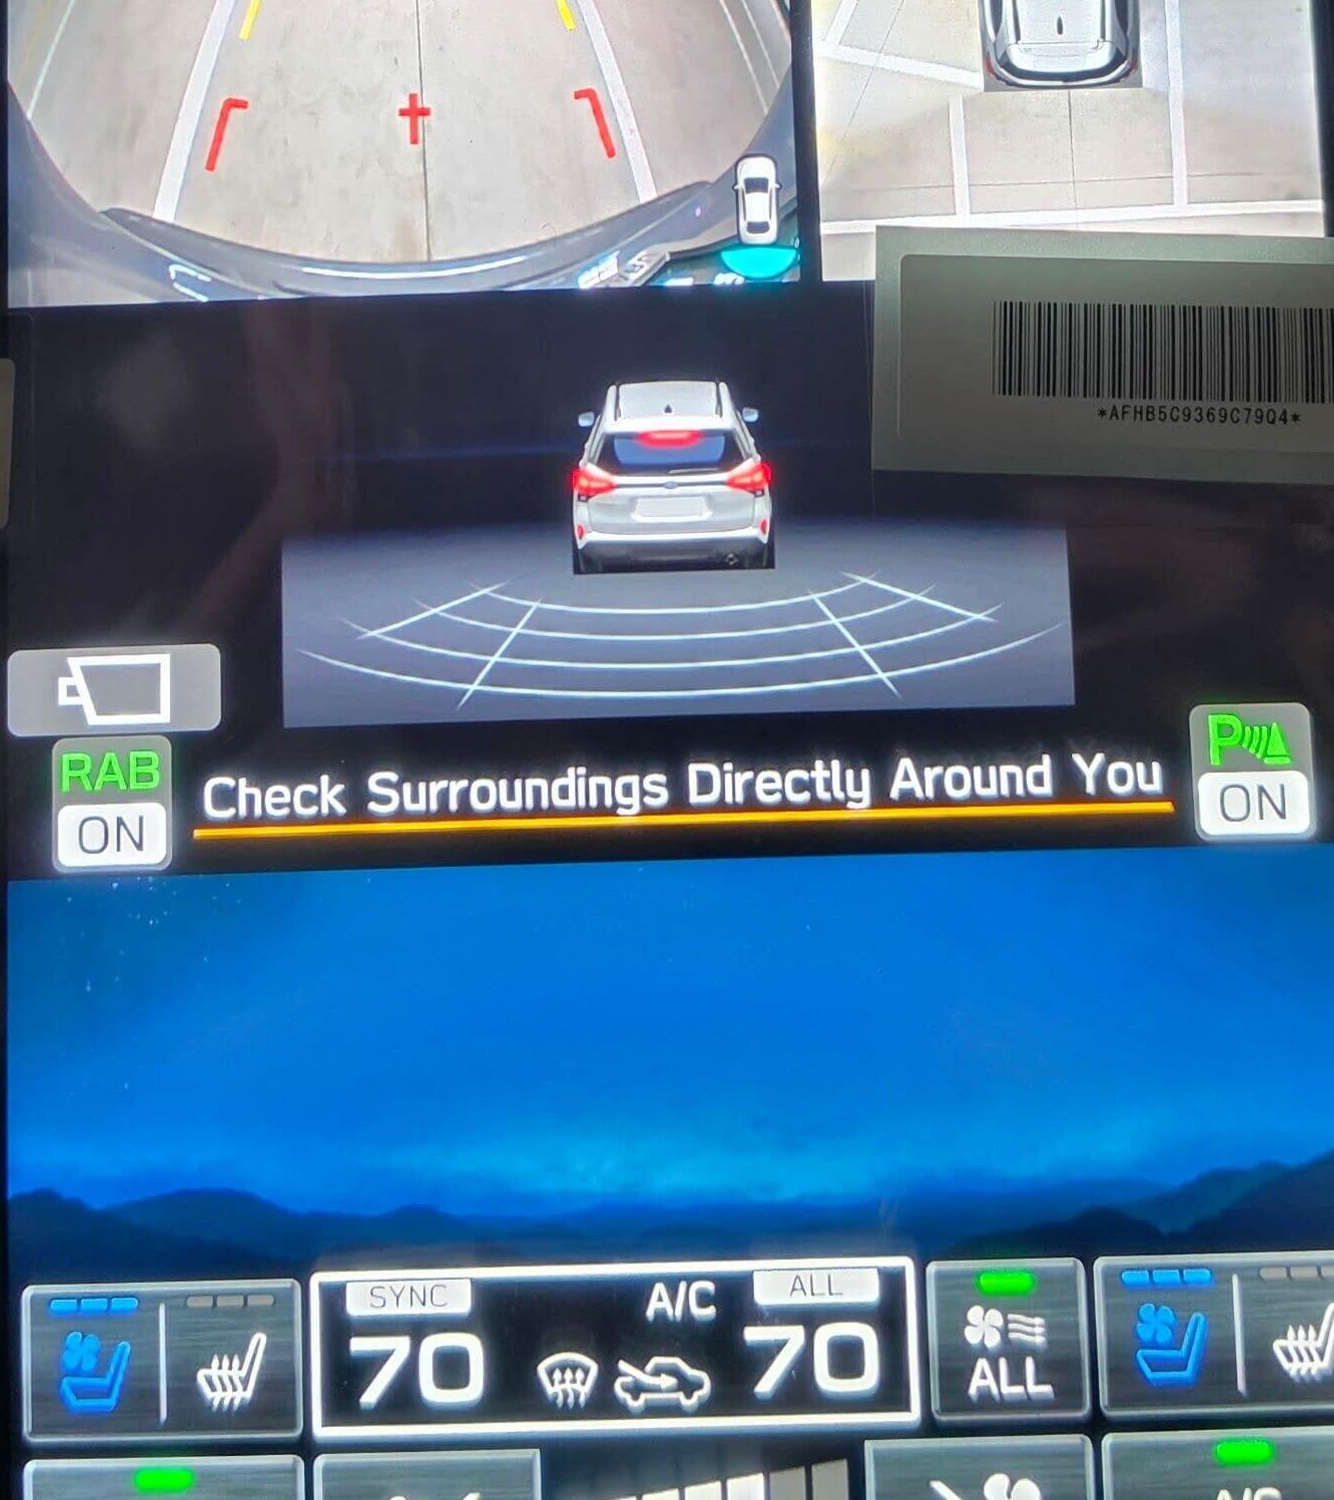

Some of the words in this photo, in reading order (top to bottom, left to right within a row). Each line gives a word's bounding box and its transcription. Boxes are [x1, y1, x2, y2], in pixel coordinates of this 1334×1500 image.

[59, 750, 161, 793] RAB
[203, 775, 347, 822] Check
[366, 764, 669, 818] Surroundings
[687, 758, 871, 810] Directly
[890, 752, 1053, 800] Around
[1072, 750, 1163, 795] You
[1219, 781, 1288, 822] ON
[77, 813, 145, 857] ON
[368, 1283, 450, 1311] SYNC
[646, 1280, 718, 1322] A/C
[789, 1270, 845, 1297] ALL
[349, 1332, 487, 1412] 70
[742, 1322, 881, 1397] 70
[968, 1355, 1055, 1400] ALL
